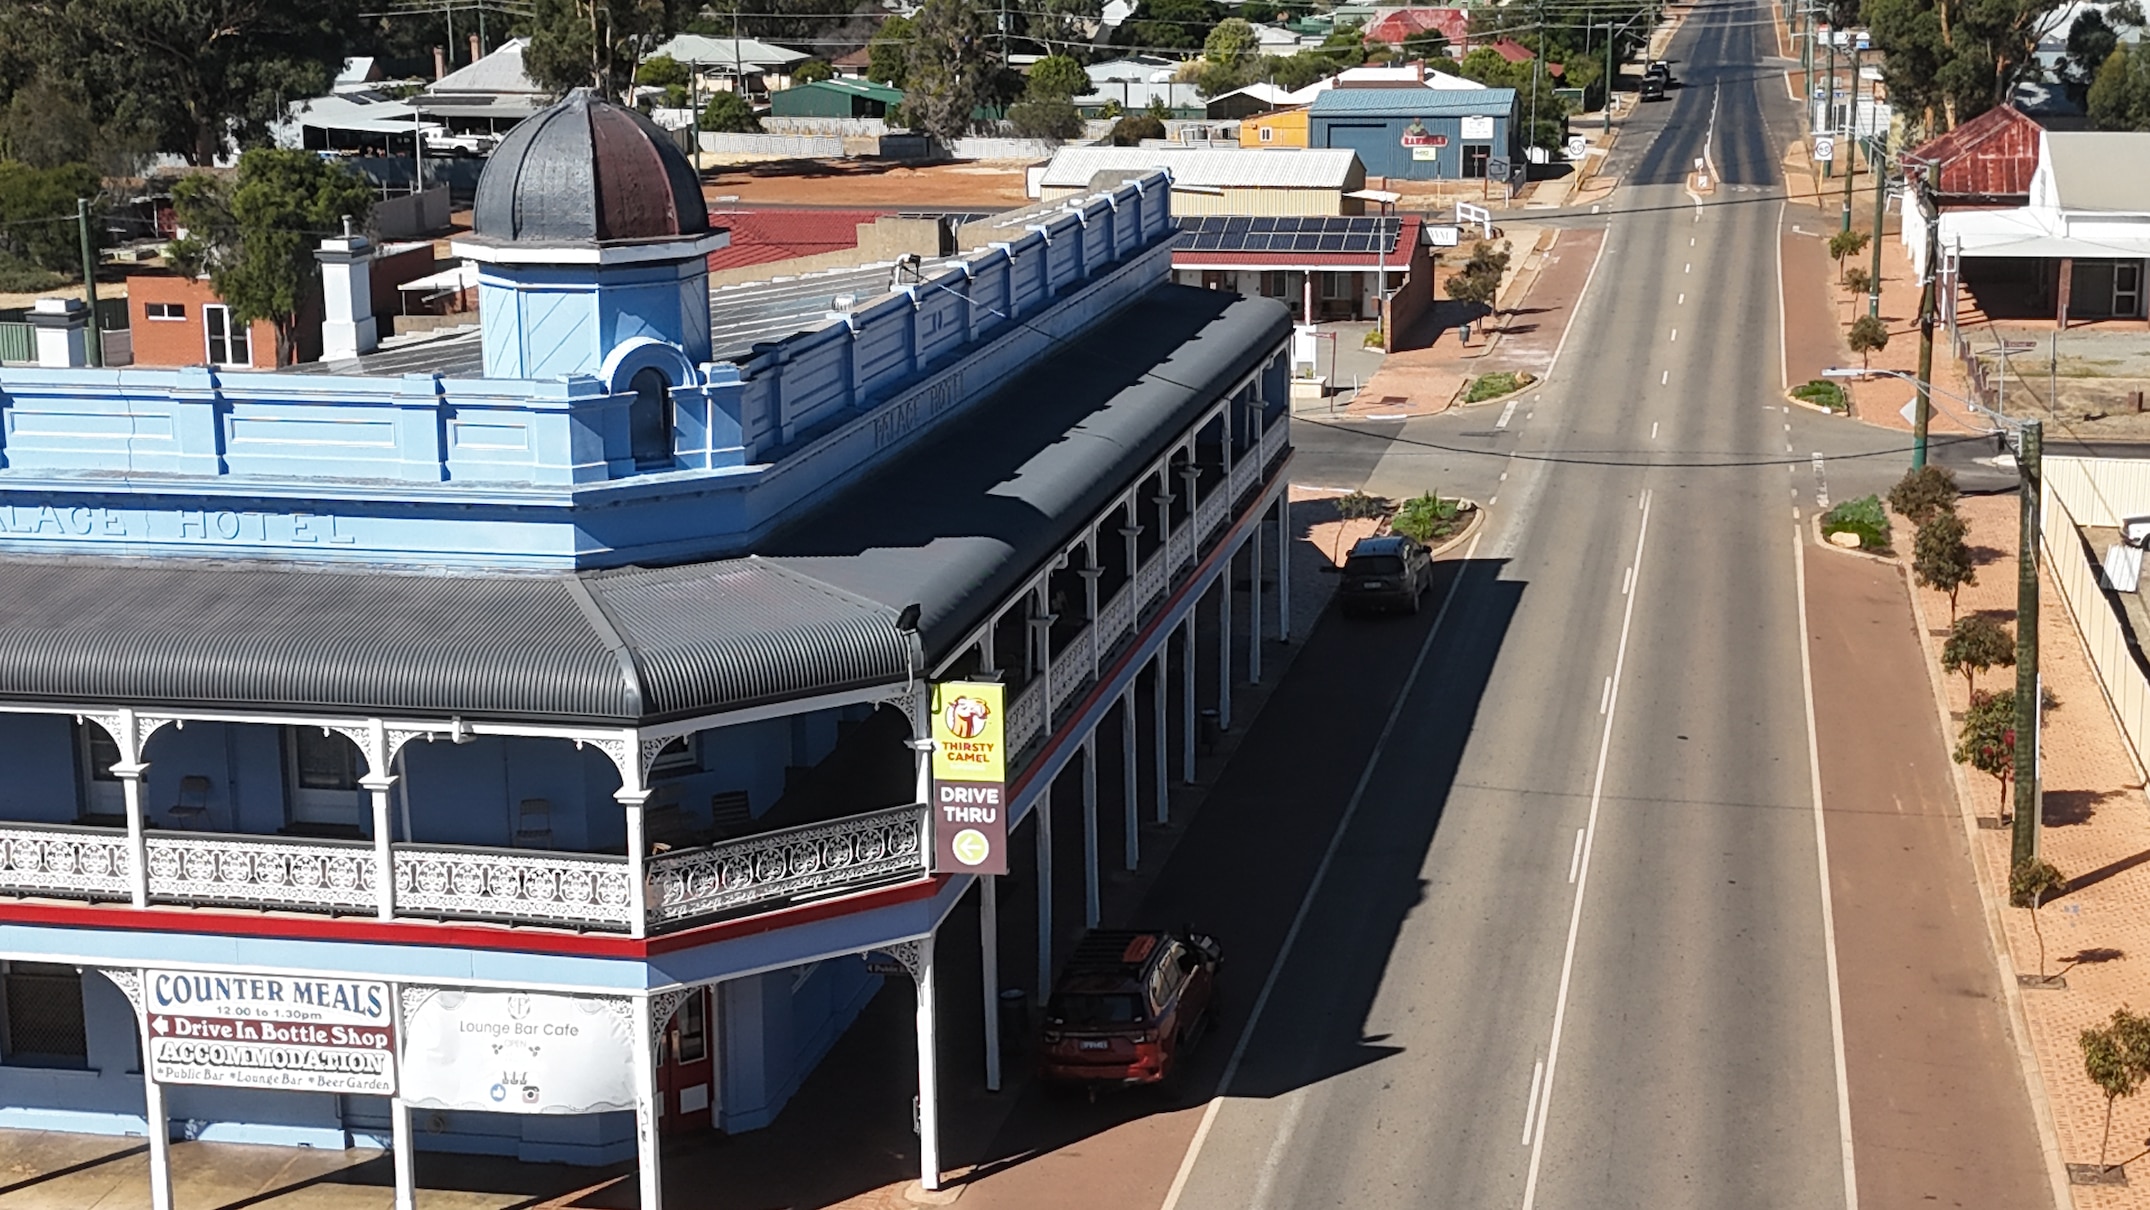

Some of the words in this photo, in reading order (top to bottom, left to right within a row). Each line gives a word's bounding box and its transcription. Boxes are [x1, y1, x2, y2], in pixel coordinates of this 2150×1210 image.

[0, 501, 127, 536] LACE
[178, 506, 356, 544] HOTEL
[942, 741, 994, 752] THIRSTY
[947, 752, 990, 763] CAMEL
[940, 786, 999, 804] DRIVE
[943, 806, 996, 823] THRU
[156, 974, 284, 1006] COUNTER
[293, 981, 382, 1018] MEALS
[256, 1008, 268, 1016] to
[274, 1009, 322, 1020] 1.30pm
[174, 1017, 234, 1039] Drive
[235, 1021, 259, 1040] In
[261, 1022, 328, 1044] Bottle
[331, 1026, 389, 1049] Shop
[460, 1020, 510, 1038] Lounge
[514, 1022, 539, 1035] Bar
[543, 1023, 579, 1036] Cafe
[157, 1041, 386, 1075] ACCOMMODATION
[165, 1066, 201, 1079] Public
[203, 1068, 225, 1081] Bar
[237, 1071, 279, 1085] Lounge
[282, 1073, 303, 1085] Bar
[317, 1075, 345, 1088] Beer
[346, 1077, 389, 1090] Garden
